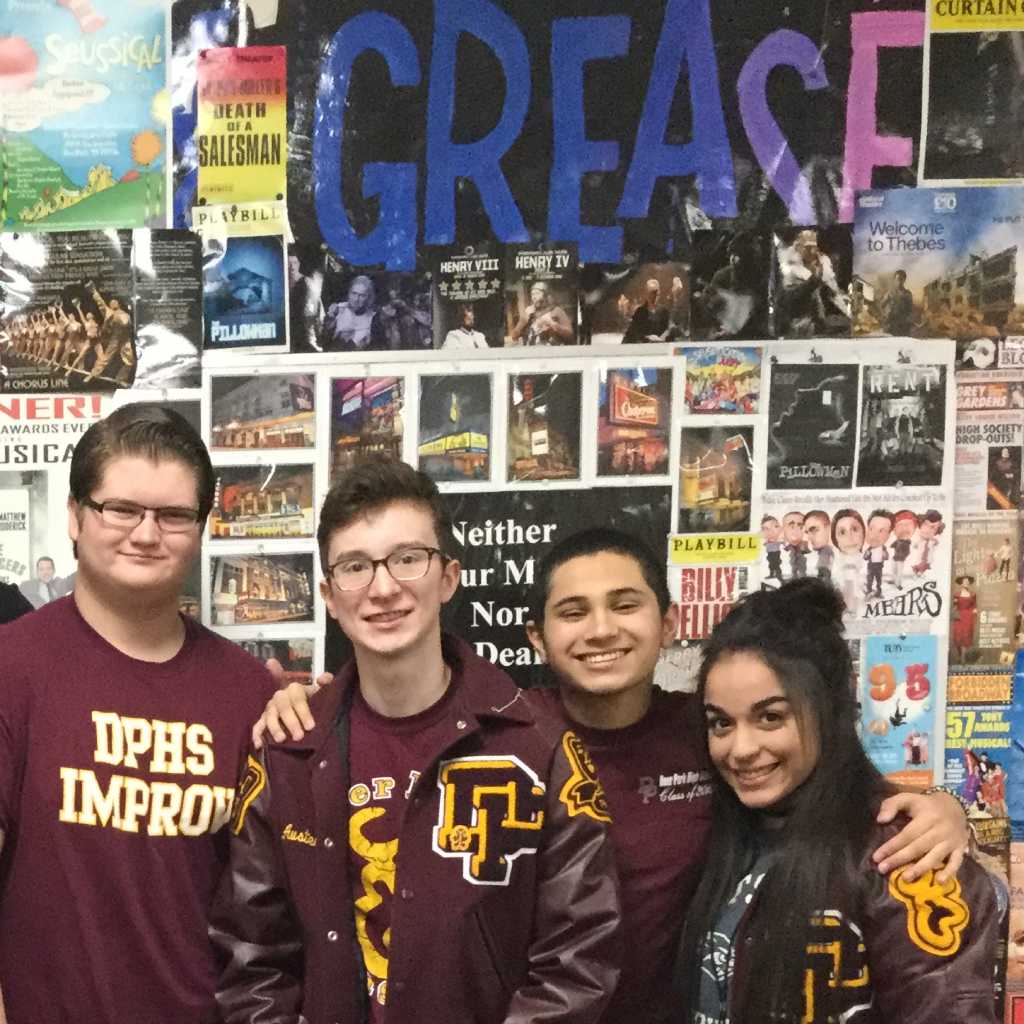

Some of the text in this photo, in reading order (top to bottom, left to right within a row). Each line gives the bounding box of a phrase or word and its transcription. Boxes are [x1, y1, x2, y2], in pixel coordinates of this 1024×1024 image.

[936, 0, 1017, 16] CURTAIN
[213, 102, 267, 119] DEATH
[226, 121, 253, 132] OF A
[198, 133, 282, 168] SALESMAN
[869, 221, 945, 236] Welcome
[868, 236, 946, 251] to Thebes
[440, 258, 499, 273] HENRY VIII
[515, 254, 570, 269] HENRY IV
[12, 378, 49, 389] CHORUS
[1, 423, 59, 434] AWARDS
[983, 423, 1022, 434] SOCIETY
[452, 519, 557, 546] Neither
[673, 537, 757, 552] PLAYBILL
[460, 559, 536, 587] ur M
[681, 567, 737, 602] BILLY
[470, 601, 529, 628] Nor
[869, 663, 896, 701] 9
[946, 711, 976, 739] 57
[91, 711, 215, 776] DPHS
[59, 767, 236, 837] IMPROV
